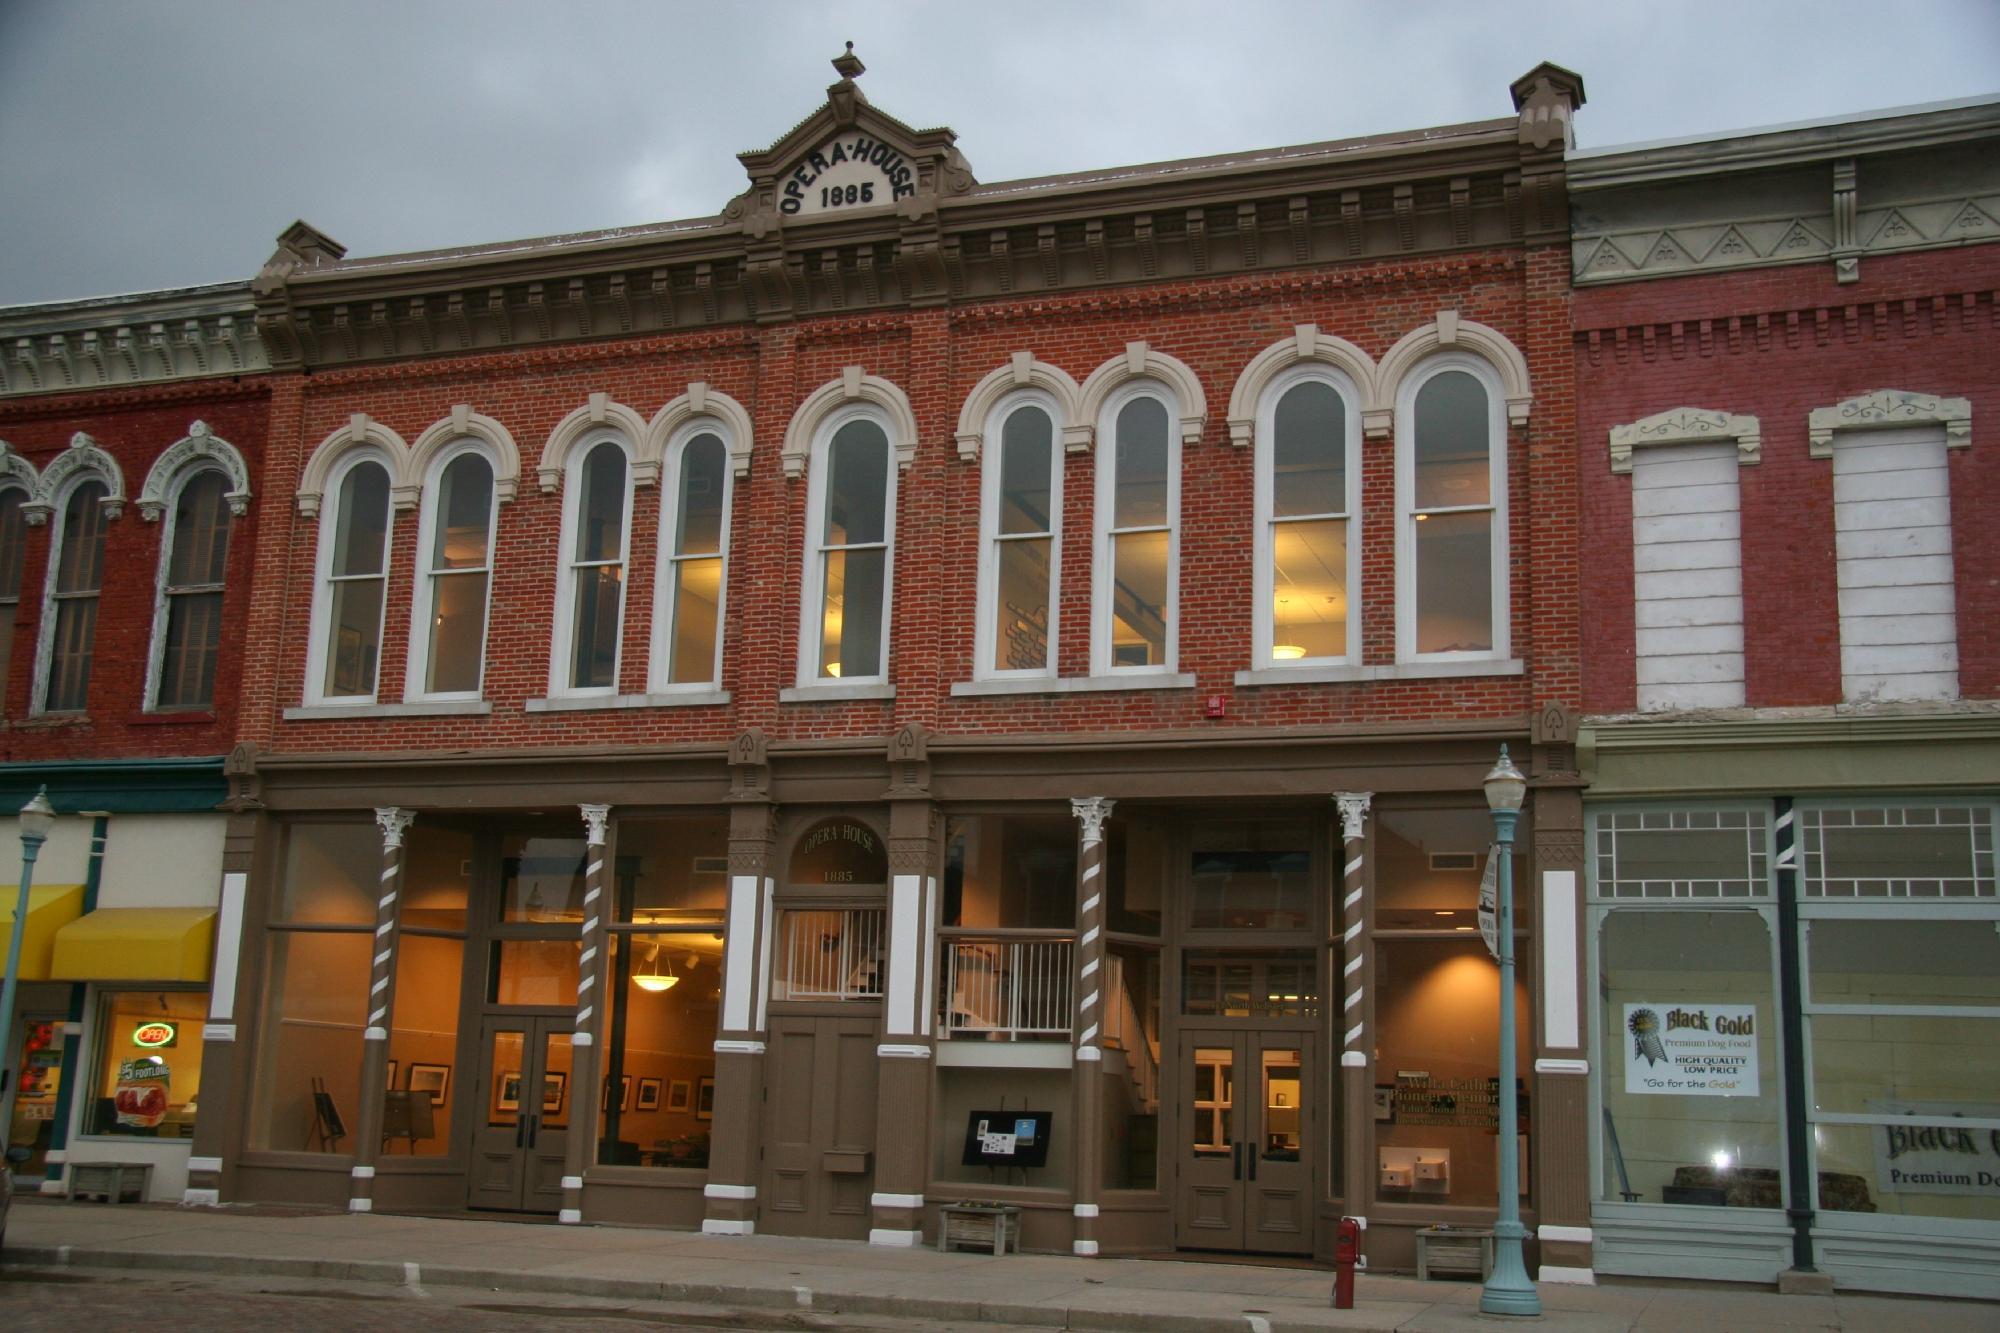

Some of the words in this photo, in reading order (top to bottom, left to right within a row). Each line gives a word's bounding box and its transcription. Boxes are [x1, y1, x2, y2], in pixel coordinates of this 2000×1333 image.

[821, 181, 874, 207] 1885
[804, 826, 837, 854] OPERA
[843, 824, 874, 853] HOUSE
[824, 871, 853, 882] 1885
[1666, 1007, 1710, 1031] Black
[1715, 1014, 1754, 1035] Gold
[139, 1028, 168, 1041] OPEN
[1665, 1039, 1705, 1048] Premium
[1707, 1040, 1726, 1050] Dog
[1728, 1040, 1751, 1048] Food
[1675, 1056, 1700, 1065] HIGH
[1703, 1057, 1747, 1065] QUALITY
[1684, 1066, 1706, 1074] LOW
[1710, 1066, 1738, 1075] PRICE
[1450, 1077, 1499, 1091] Cather
[1667, 1078, 1685, 1088] for
[1687, 1079, 1706, 1088] the
[1446, 1090, 1499, 1104] Memor
[1890, 1169, 1971, 1186] Premium
[1977, 1171, 2000, 1187] Do
